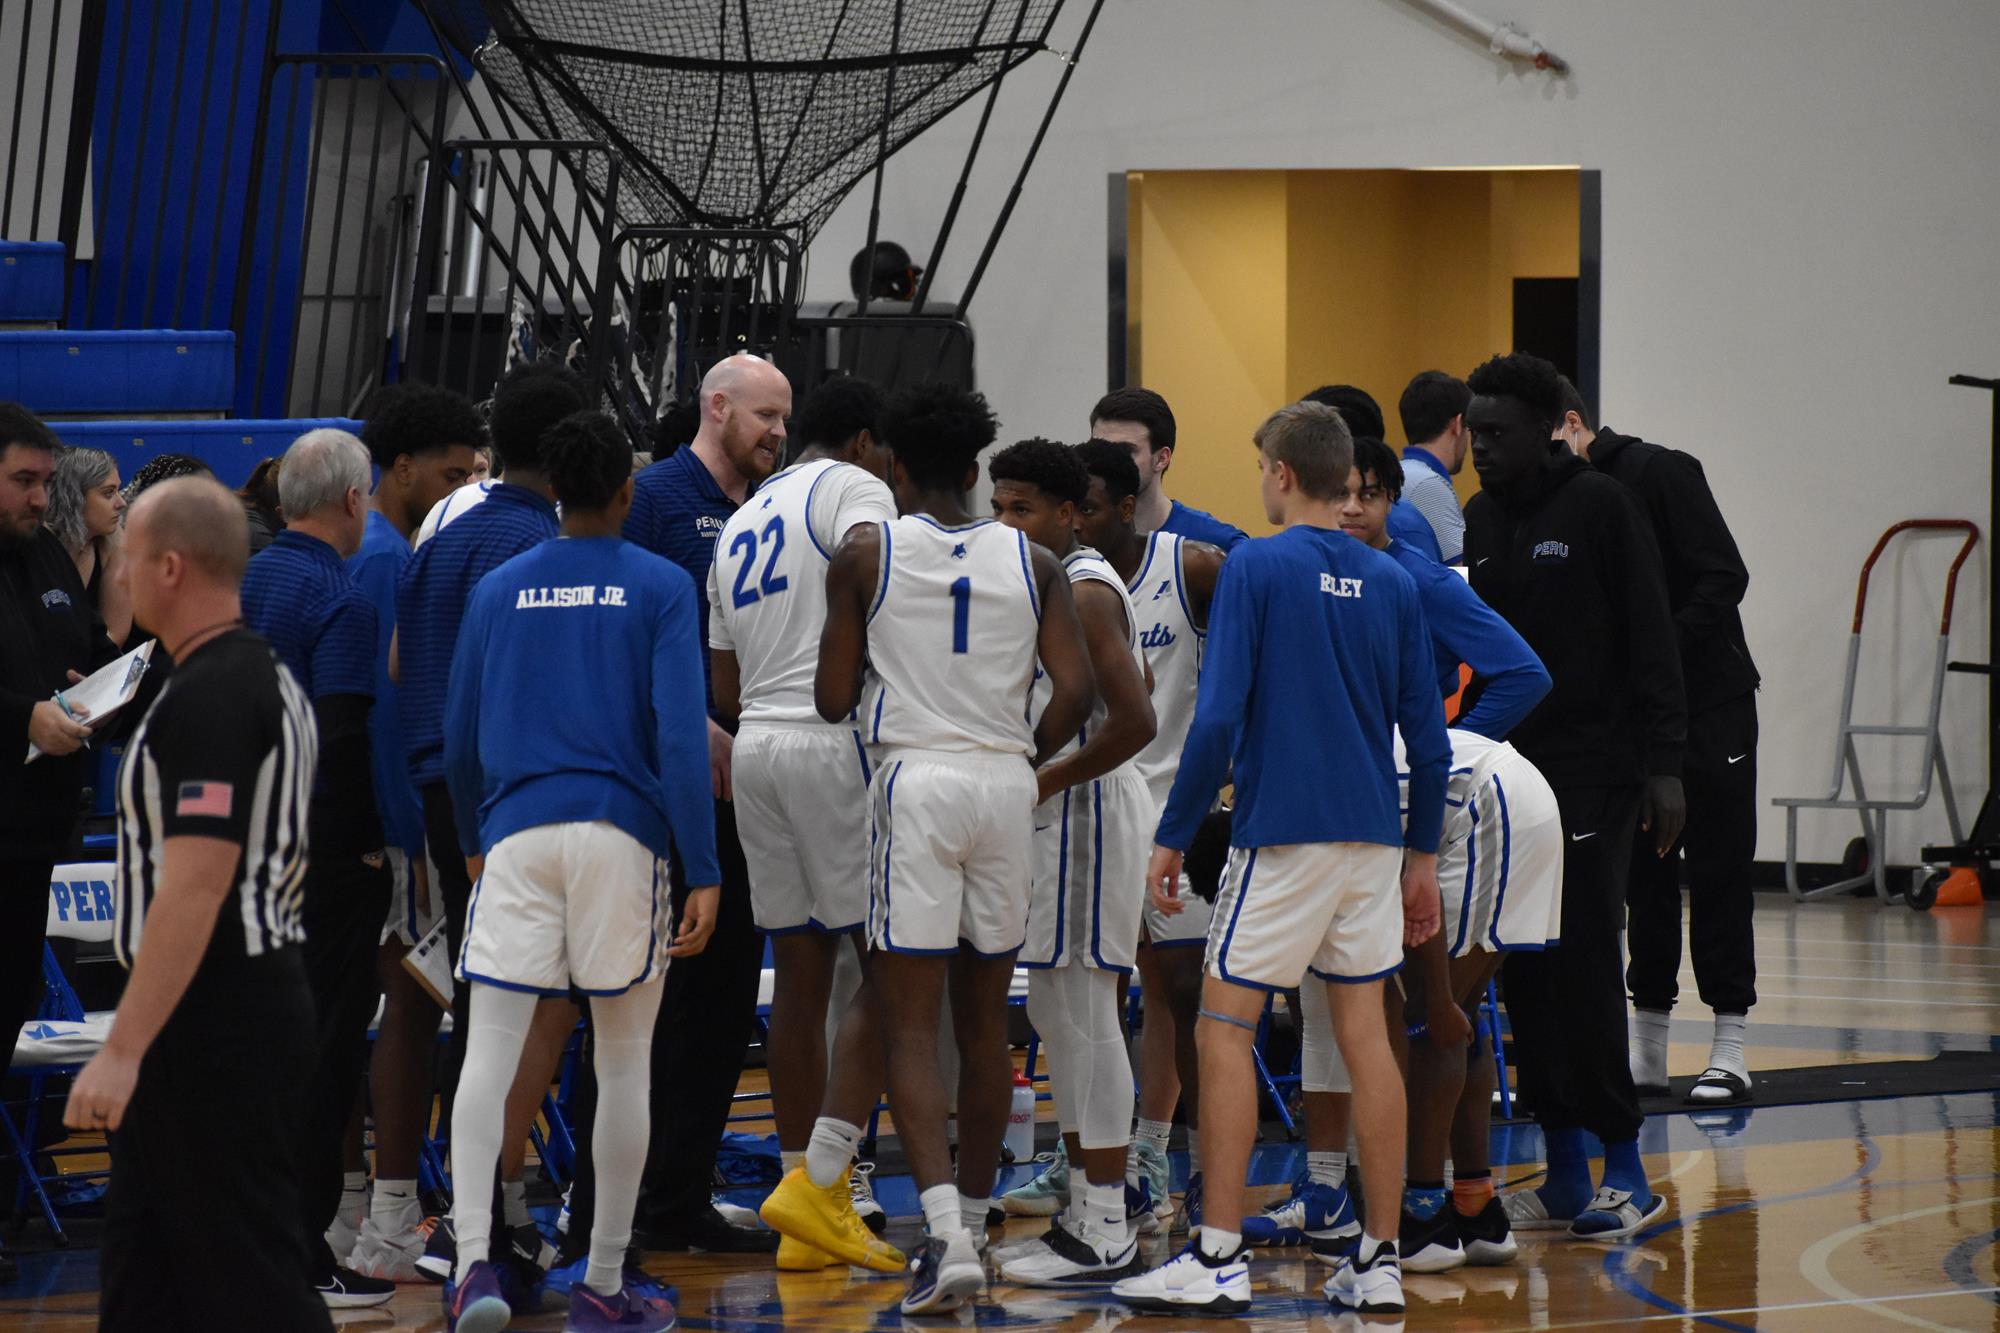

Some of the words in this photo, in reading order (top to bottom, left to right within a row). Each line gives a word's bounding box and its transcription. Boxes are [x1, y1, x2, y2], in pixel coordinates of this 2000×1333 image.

[729, 514, 788, 611] 22
[1533, 540, 1569, 559] PERU
[516, 585, 596, 609] ALLISON
[598, 586, 628, 606] JR.
[949, 576, 971, 654] 1
[50, 879, 115, 922] PER
